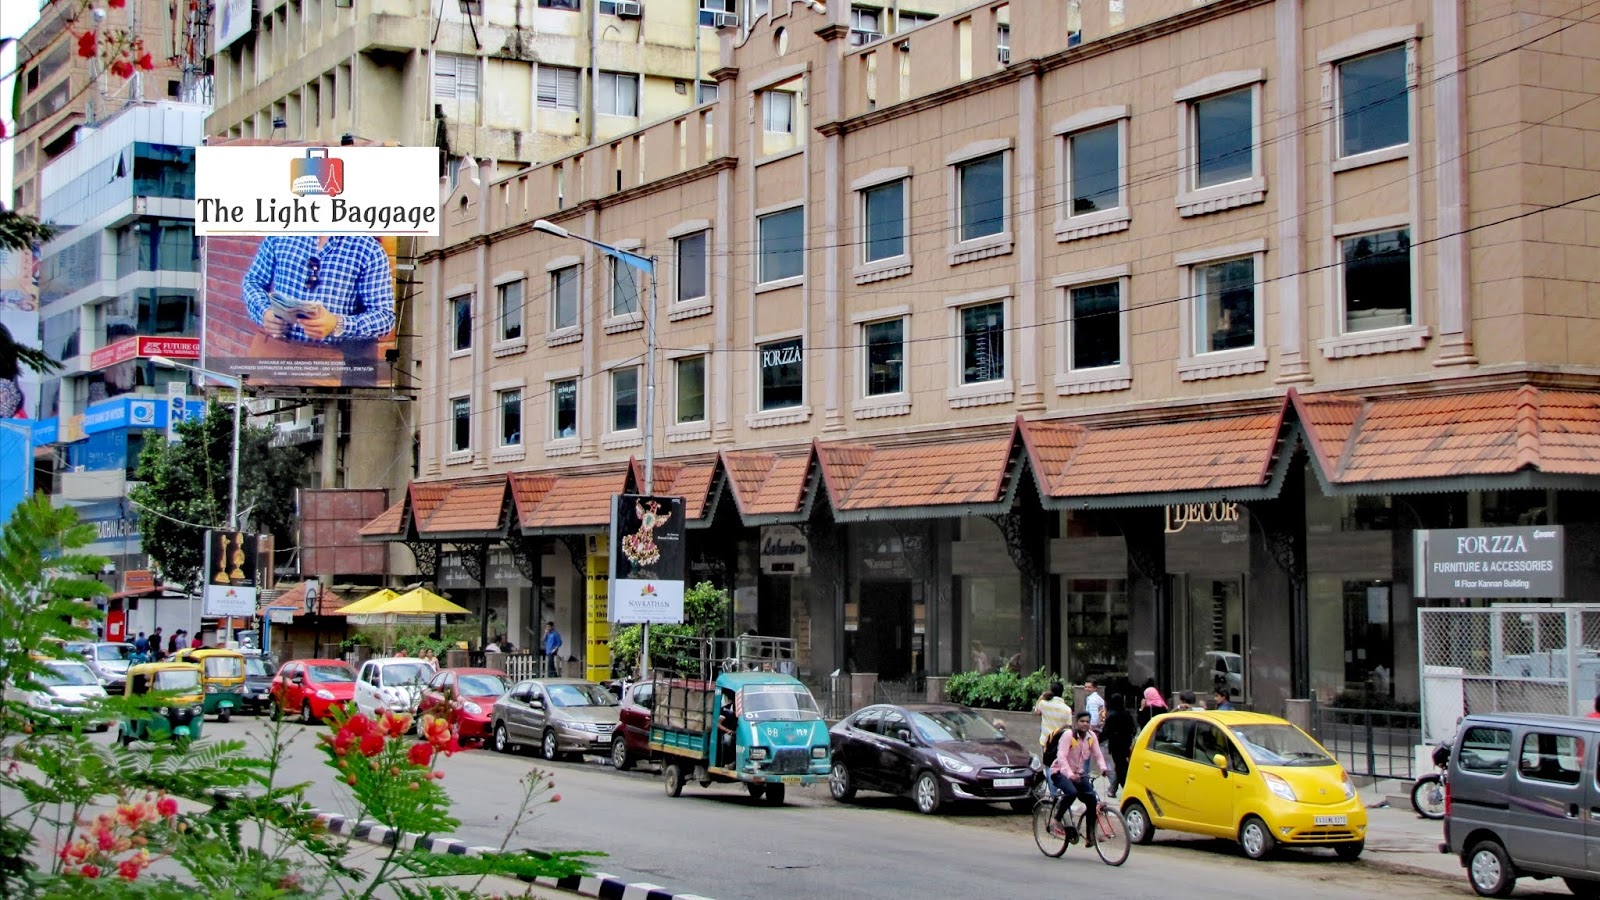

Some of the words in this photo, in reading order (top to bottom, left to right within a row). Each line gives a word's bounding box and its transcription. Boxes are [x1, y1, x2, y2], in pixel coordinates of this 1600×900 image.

[763, 346, 801, 367] FORZZA
[1457, 535, 1527, 554] FORZZA
[1434, 562, 1480, 573] FURNITURE
[1482, 562, 1488, 572] &
[1490, 560, 1553, 572] ACCESSORIES
[1461, 580, 1477, 588] Floor
[1478, 580, 1502, 588] Kannan
[1503, 579, 1530, 589] Building
[628, 600, 670, 608] NAVRATHAN
